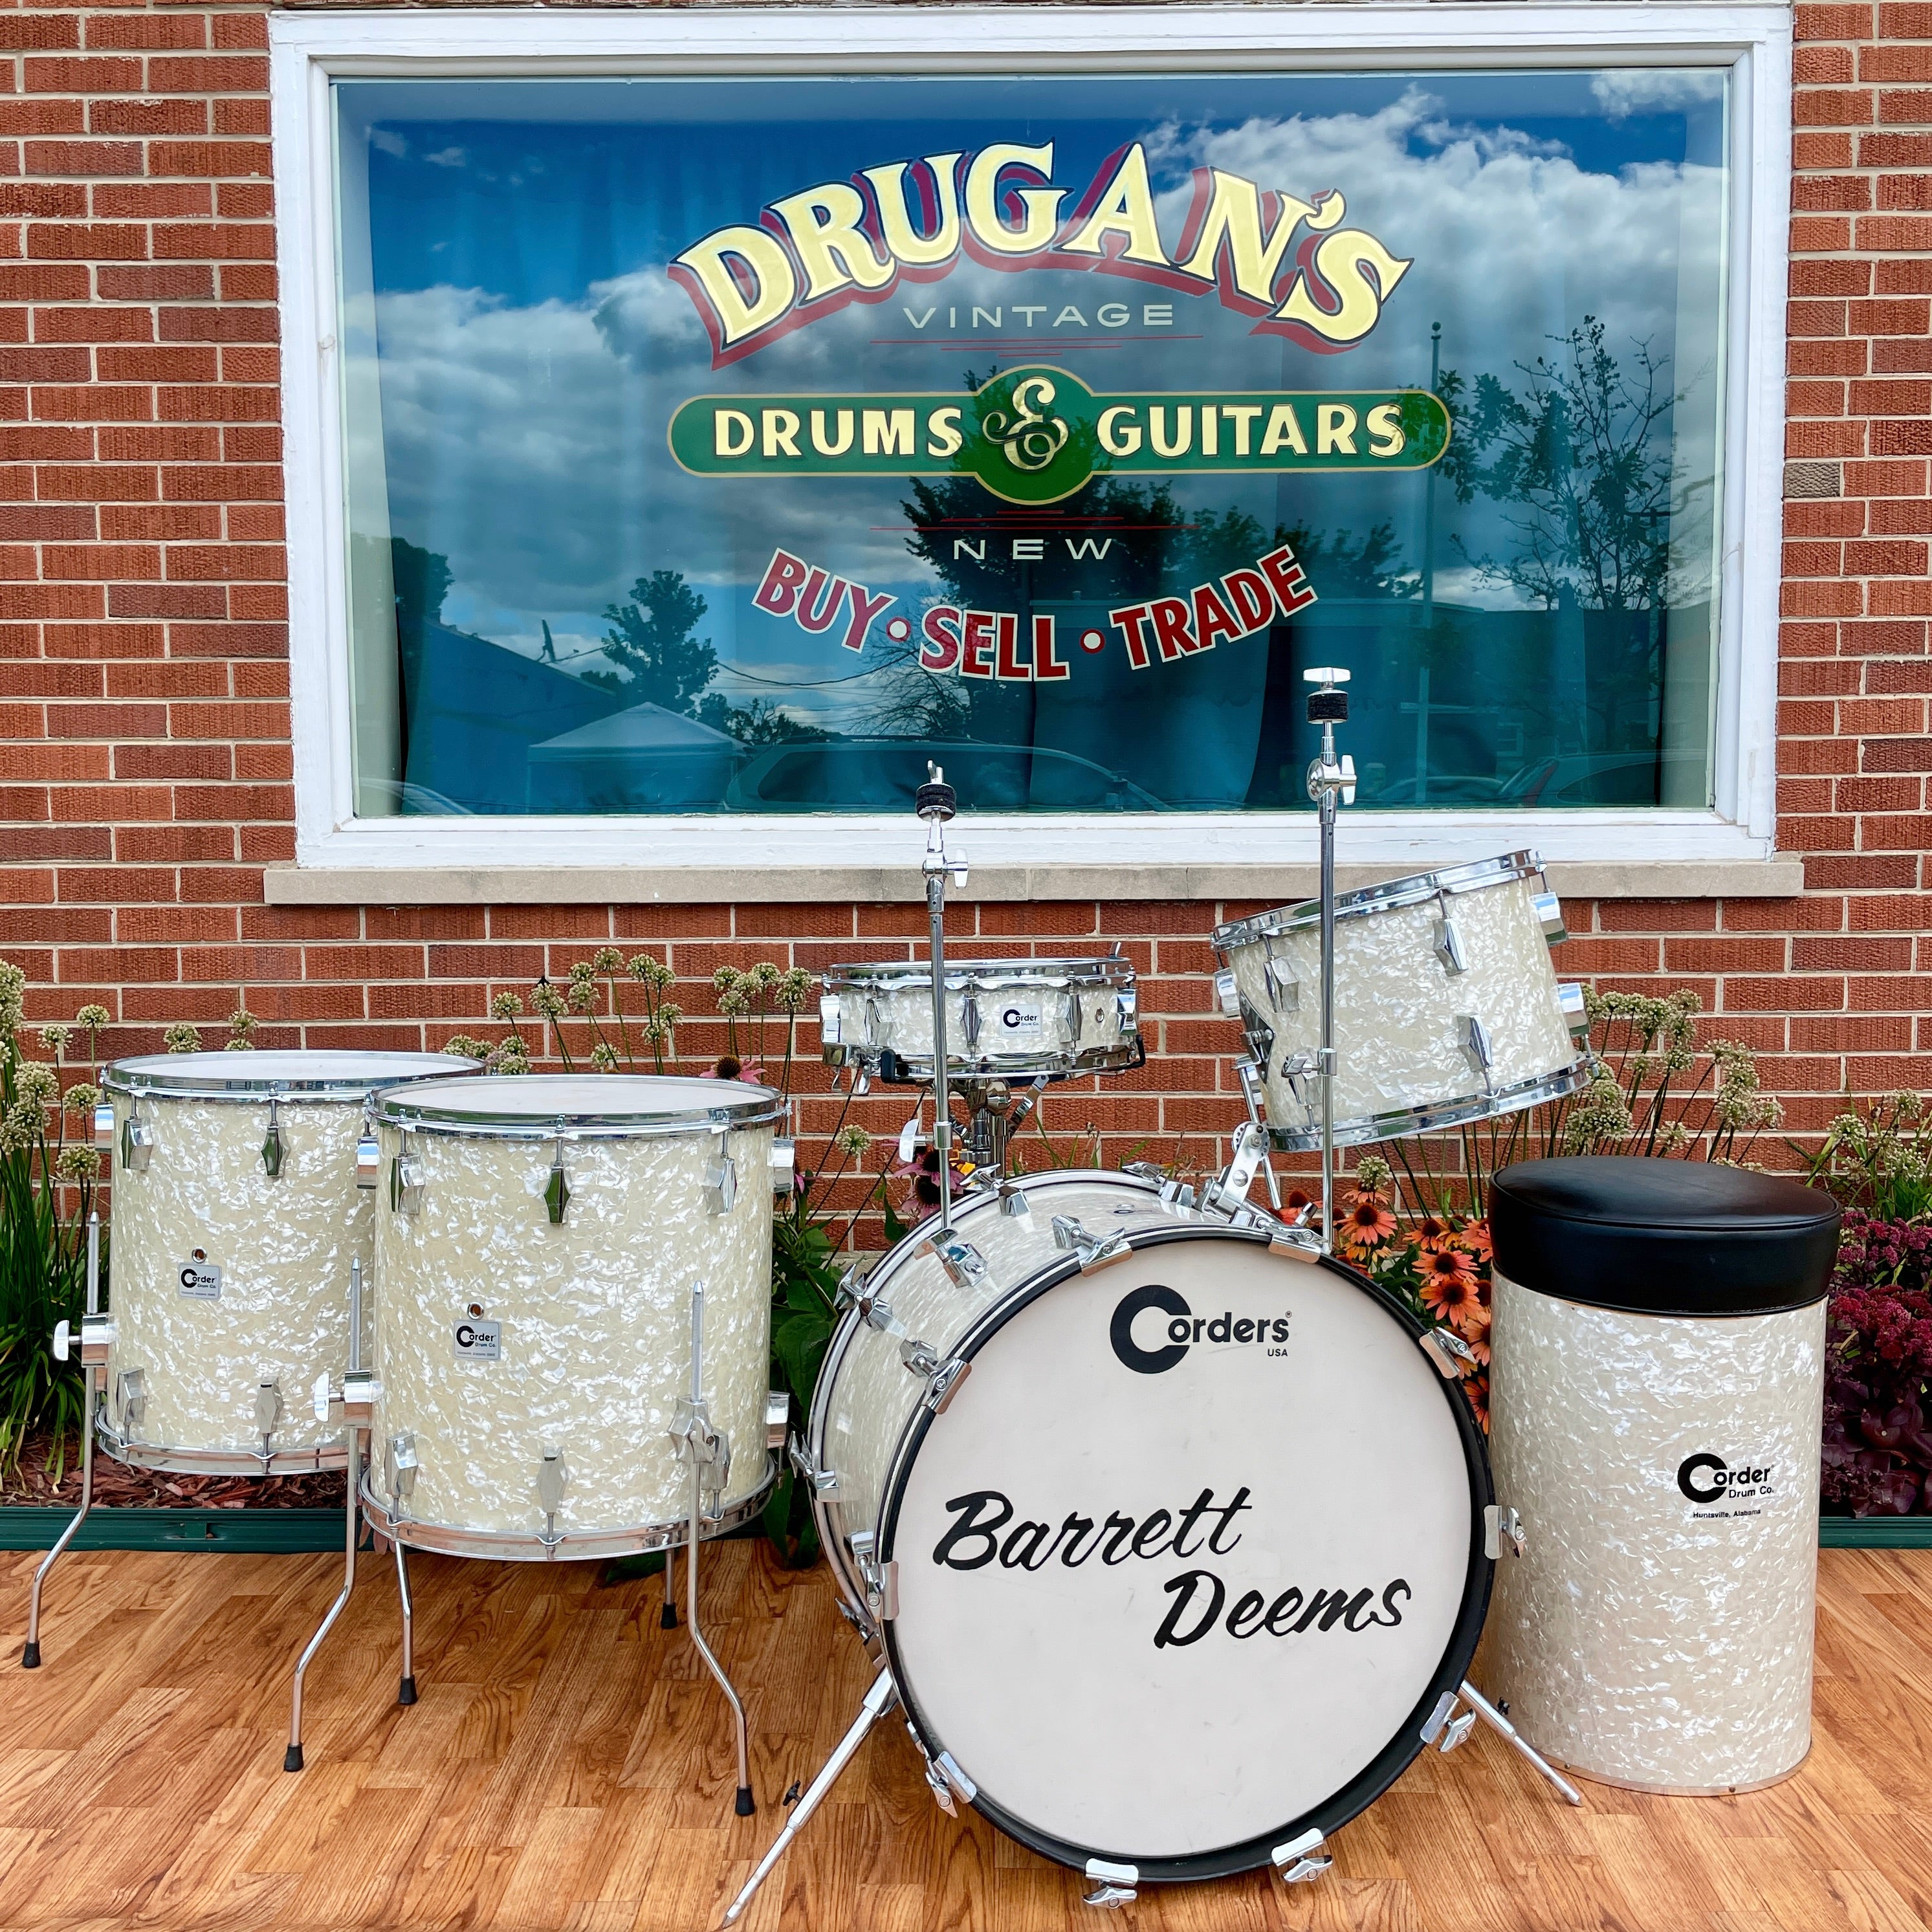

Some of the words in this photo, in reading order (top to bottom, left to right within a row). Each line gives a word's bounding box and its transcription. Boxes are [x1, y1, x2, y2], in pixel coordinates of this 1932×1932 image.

[669, 138, 1413, 368] DRUGAN'S
[903, 304, 1174, 329] VINTAGE
[714, 406, 963, 458] DRUMS
[982, 374, 1069, 472] &
[1097, 404, 1407, 458] GUITARS
[954, 538, 1113, 560] NEW
[752, 547, 899, 653] BUY
[919, 606, 1070, 682] SELL
[1110, 543, 1318, 669] TRADE
[1003, 1009, 1037, 1027] Corder
[181, 1268, 215, 1288] Corder
[456, 1325, 494, 1348] Corder
[1110, 1284, 1290, 1374] Corders
[1268, 1348, 1288, 1357] USA
[1677, 1453, 1771, 1504] Corder
[1728, 1489, 1756, 1498] Drum
[1759, 1486, 1774, 1495] Co.
[1733, 1508, 1761, 1517] Alabama
[932, 1486, 1253, 1571] Barrett
[1153, 1570, 1412, 1649] Deems
